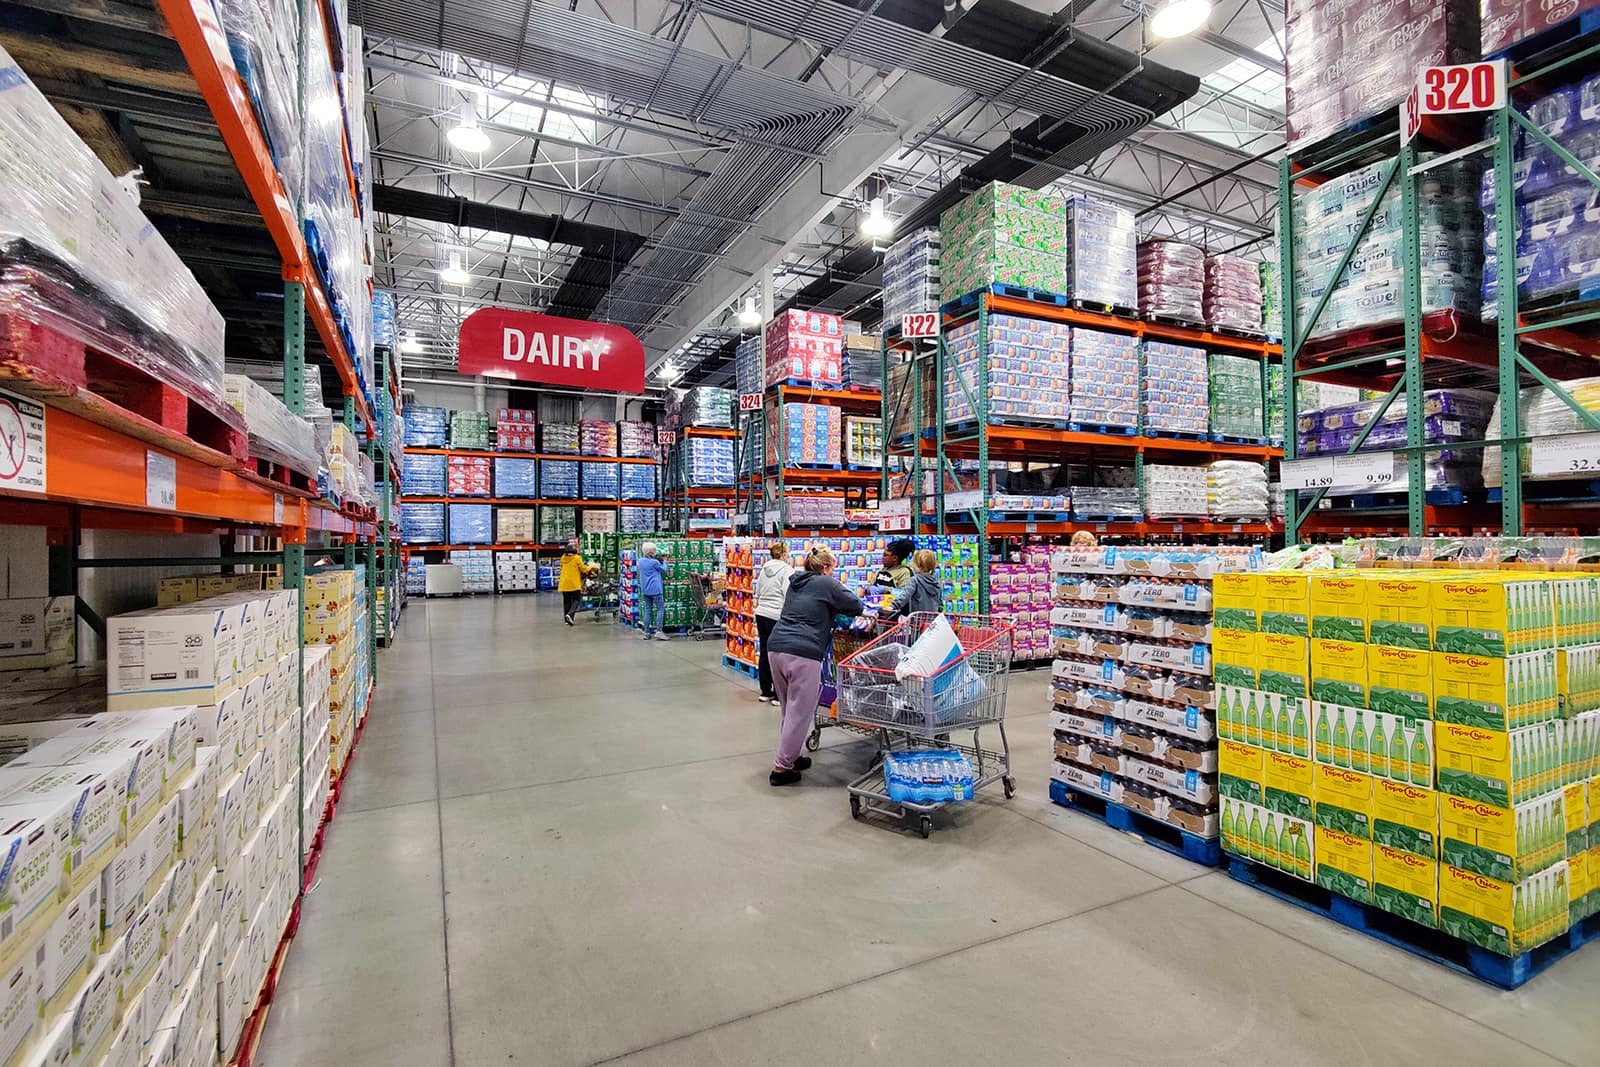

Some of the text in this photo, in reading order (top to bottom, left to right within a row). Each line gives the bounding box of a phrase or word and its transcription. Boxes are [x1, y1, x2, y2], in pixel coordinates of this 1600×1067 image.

[1425, 65, 1495, 111] 320
[1407, 84, 1420, 138] 32
[1340, 171, 1382, 196] Towel
[1346, 211, 1389, 234] Toel
[1355, 289, 1398, 307] Towel
[904, 314, 936, 336] 322
[503, 327, 606, 371] DAIRY
[741, 394, 761, 410] 324
[659, 432, 674, 443] 326
[1304, 477, 1333, 487] 14.89
[1366, 473, 1391, 484] 9.99
[1143, 588, 1162, 596] ZERO
[1444, 584, 1488, 595] Topo Chico
[1152, 649, 1170, 658] ZERO
[1445, 655, 1489, 667] Topo Chico
[1070, 665, 1086, 673] ZERO
[1146, 708, 1165, 718] ZERO
[1068, 718, 1085, 727] ZERO
[1406, 719, 1414, 728] 18
[1448, 726, 1494, 741] Topo Chico
[1270, 752, 1307, 770] Topo Chico
[1147, 767, 1164, 779] ZERO
[1322, 765, 1363, 784] Topo Chico
[1381, 780, 1428, 800] Topo Chico
[83, 795, 115, 827] coconut
[1449, 797, 1474, 812] Topo
[1472, 804, 1503, 818] Chico
[87, 811, 112, 836] water
[1322, 827, 1364, 848] Topo Chico
[14, 841, 55, 884] coconut
[1381, 846, 1428, 869] Topo Chico
[20, 862, 50, 895] water
[1449, 866, 1474, 884] Topo
[1472, 875, 1503, 892] Chico
